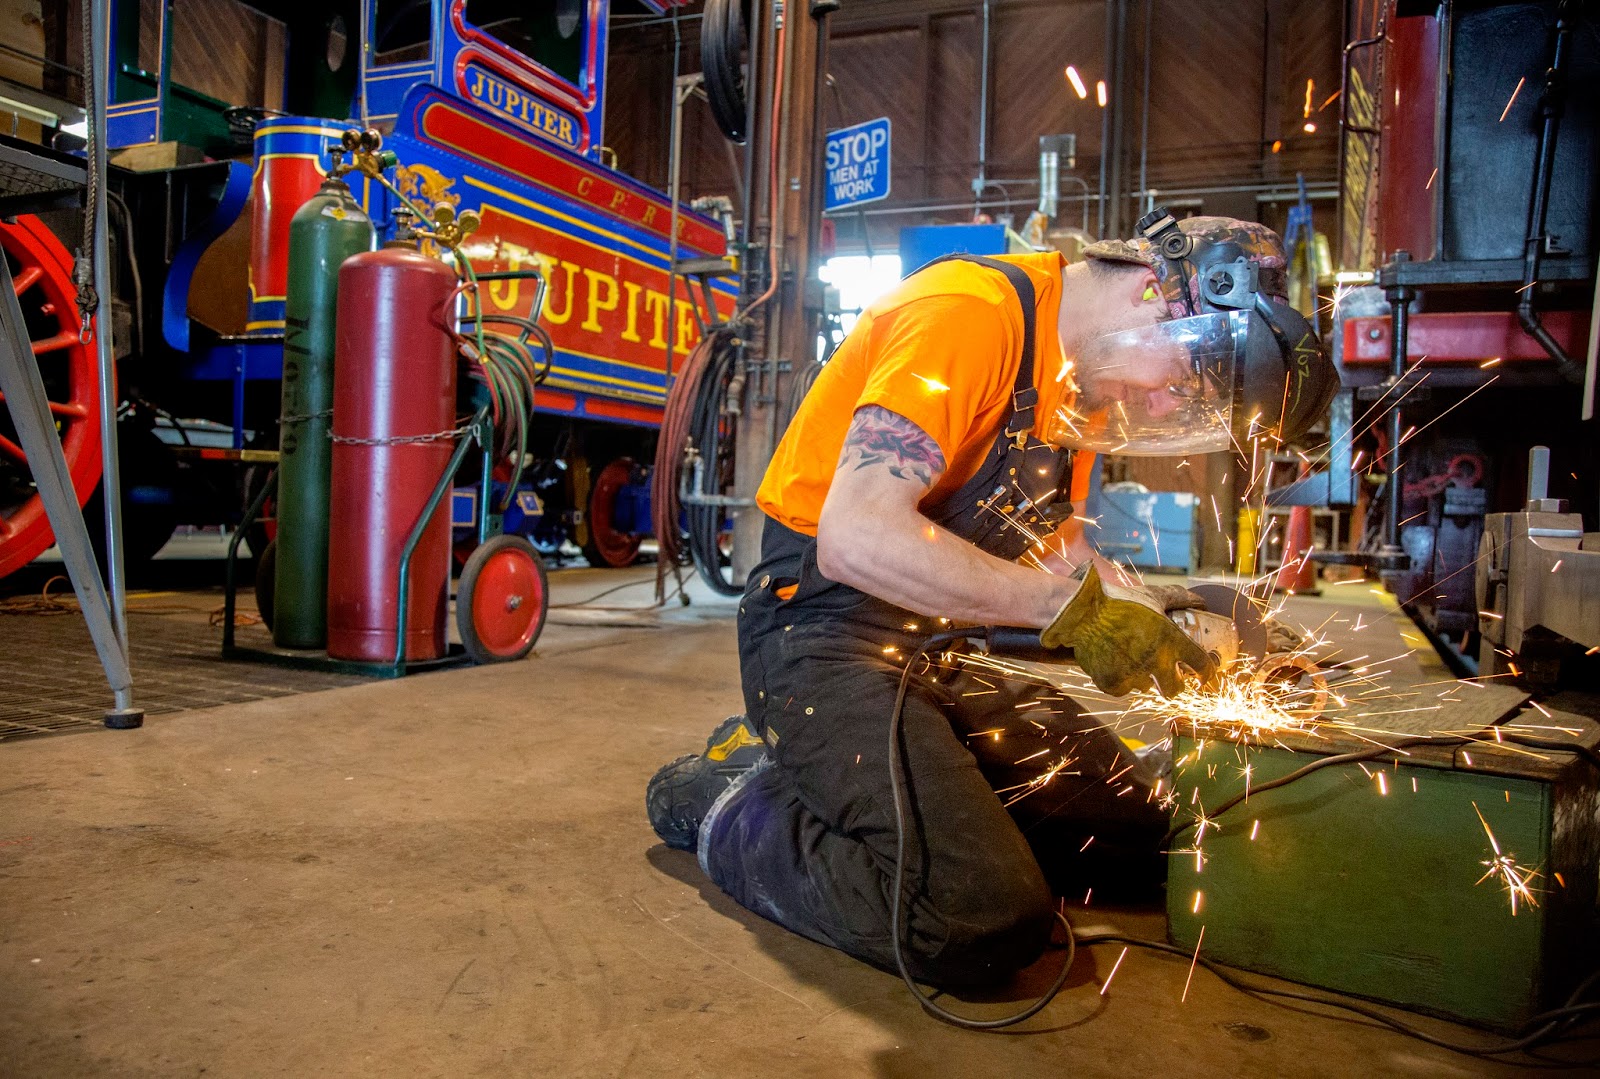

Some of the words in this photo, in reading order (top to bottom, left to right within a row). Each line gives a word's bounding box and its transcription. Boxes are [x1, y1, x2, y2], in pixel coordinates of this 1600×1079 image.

[471, 71, 574, 143] JUPITER
[825, 128, 886, 170] STOP
[829, 164, 858, 185] MEN
[863, 159, 880, 177] AT
[834, 178, 874, 200] WORK
[488, 241, 731, 355] JUPITE
